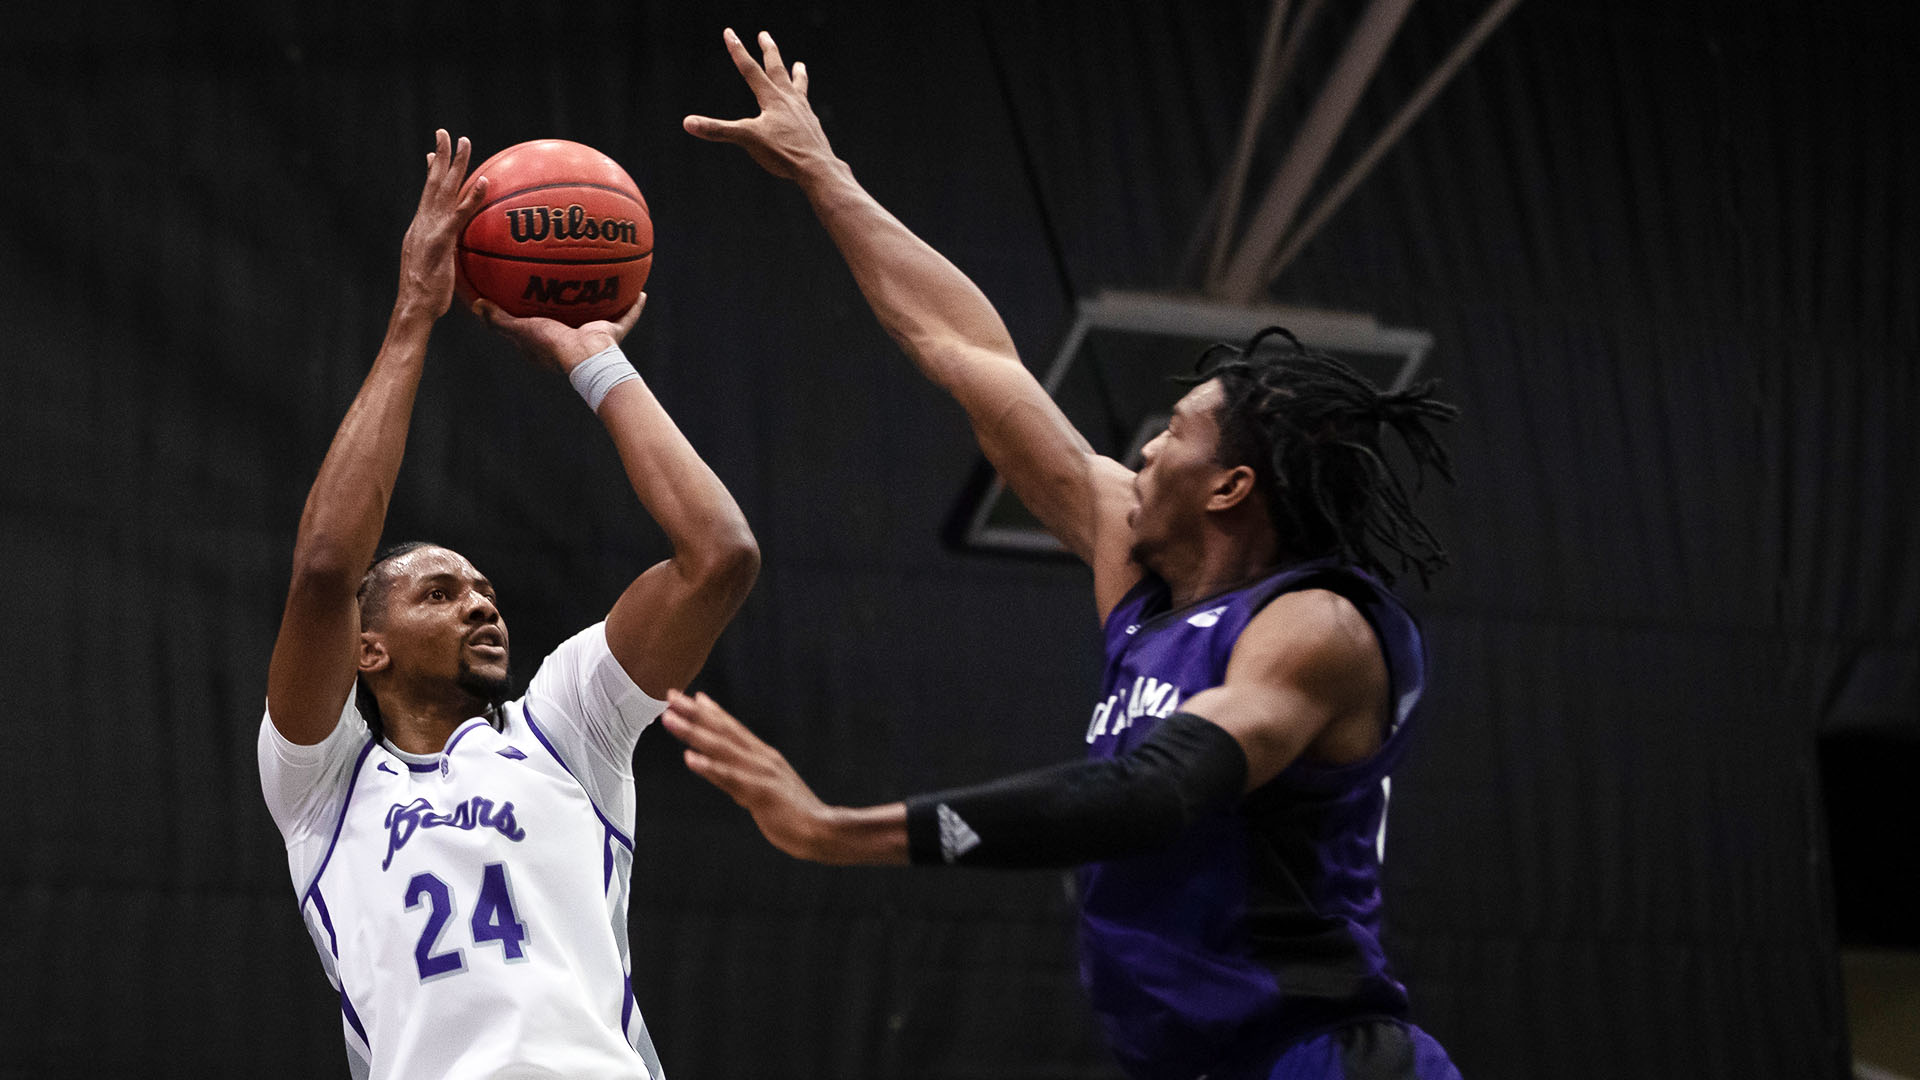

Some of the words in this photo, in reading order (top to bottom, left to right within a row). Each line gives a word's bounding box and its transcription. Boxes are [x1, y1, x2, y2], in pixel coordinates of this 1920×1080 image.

[506, 205, 639, 245] Wilson
[522, 275, 620, 305] NCAA
[404, 861, 531, 984] 24
